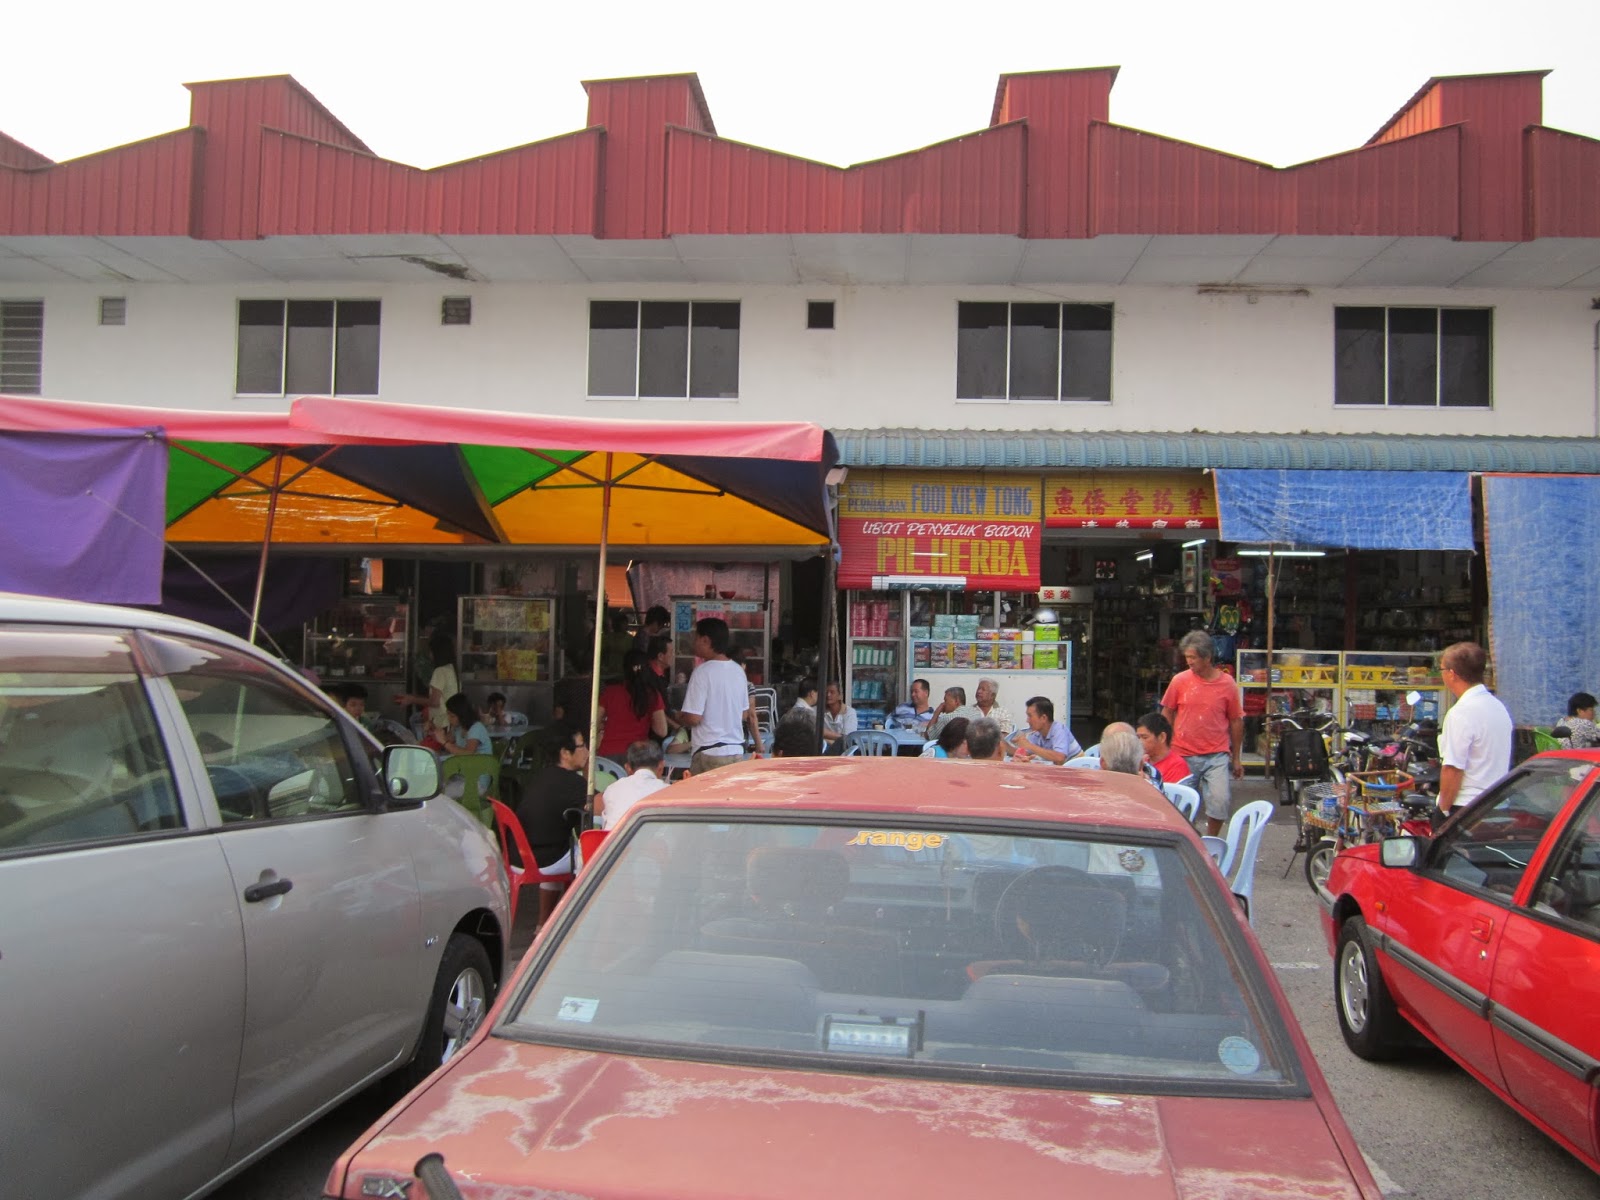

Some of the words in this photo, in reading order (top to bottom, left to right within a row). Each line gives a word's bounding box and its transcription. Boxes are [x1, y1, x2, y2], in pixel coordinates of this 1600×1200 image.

[951, 485, 987, 515] KIEW
[992, 486, 1032, 516] TONG
[862, 521, 904, 535] UBAT
[907, 523, 981, 537] PENYEJUK
[984, 525, 1035, 538] BADAN
[876, 537, 924, 574] PIL
[930, 538, 1030, 576] HERBA
